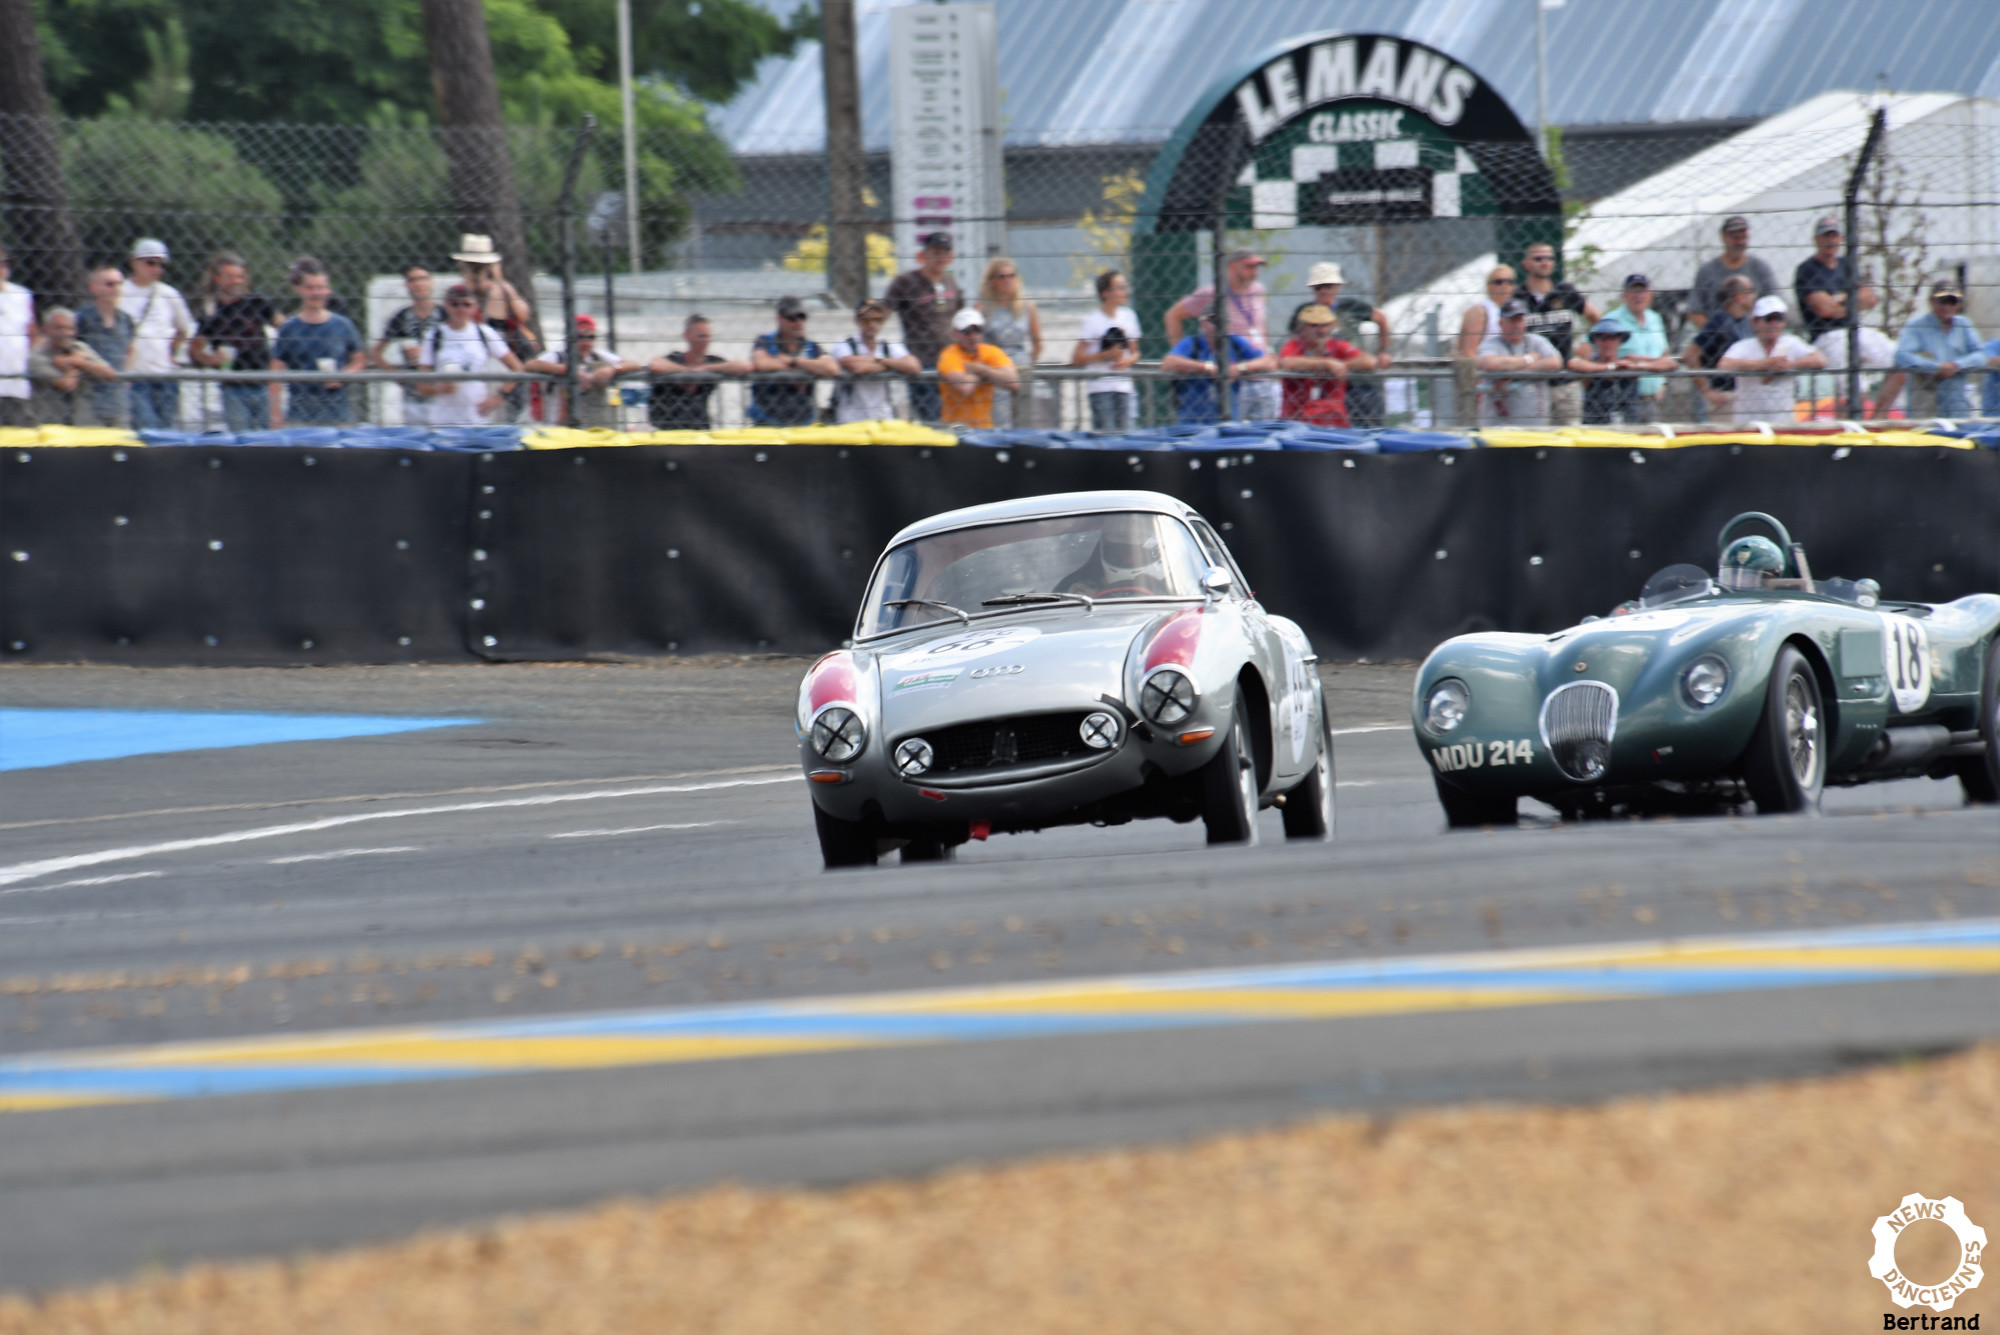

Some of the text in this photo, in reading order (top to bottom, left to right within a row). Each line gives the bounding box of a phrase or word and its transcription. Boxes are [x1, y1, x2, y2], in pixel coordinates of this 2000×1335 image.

[1236, 38, 1476, 144] LE MANS
[1308, 109, 1406, 142] CLASSIC
[1893, 622, 1922, 690] 18
[1431, 739, 1534, 773] MDU 214
